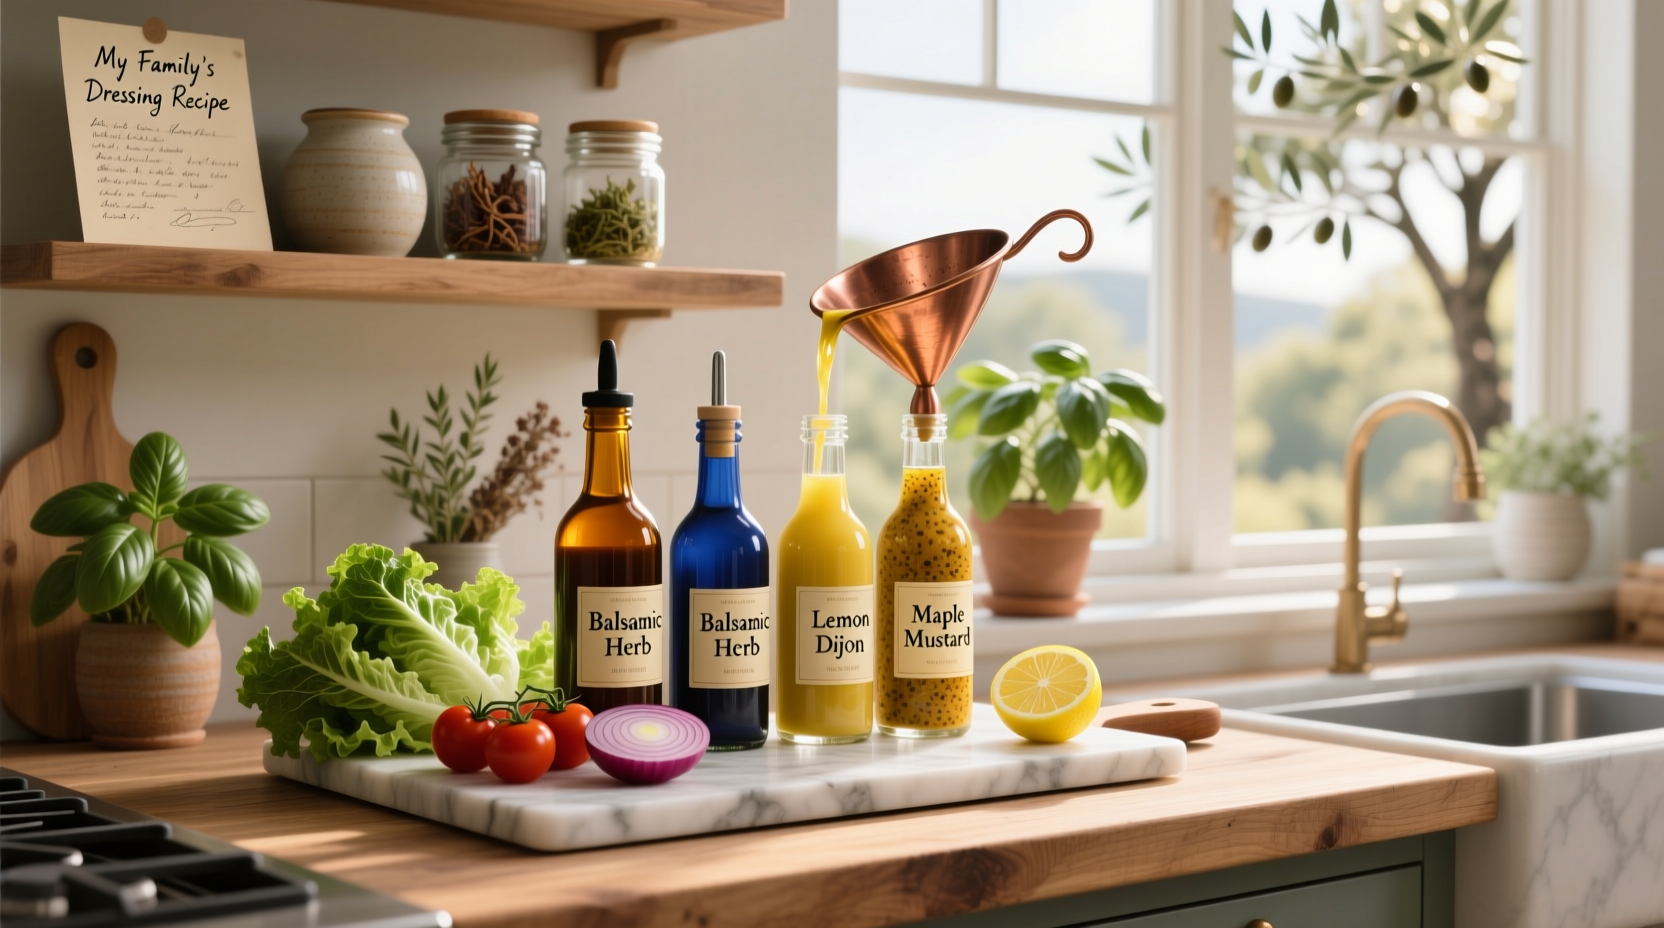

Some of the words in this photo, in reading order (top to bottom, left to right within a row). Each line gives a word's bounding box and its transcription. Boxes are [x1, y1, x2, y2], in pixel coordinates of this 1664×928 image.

[94, 45, 127, 82] My
[138, 49, 215, 87] Family's
[84, 78, 162, 117] Dressing
[172, 84, 230, 119] Recipe
[588, 610, 662, 632] Balsamic
[699, 611, 769, 632] Balsamic
[811, 609, 870, 629] Lemon
[911, 604, 965, 630] Maple
[604, 635, 652, 657] Herb
[713, 636, 760, 657] Herb
[815, 634, 865, 660] Dijon
[903, 626, 971, 648] Mustard
